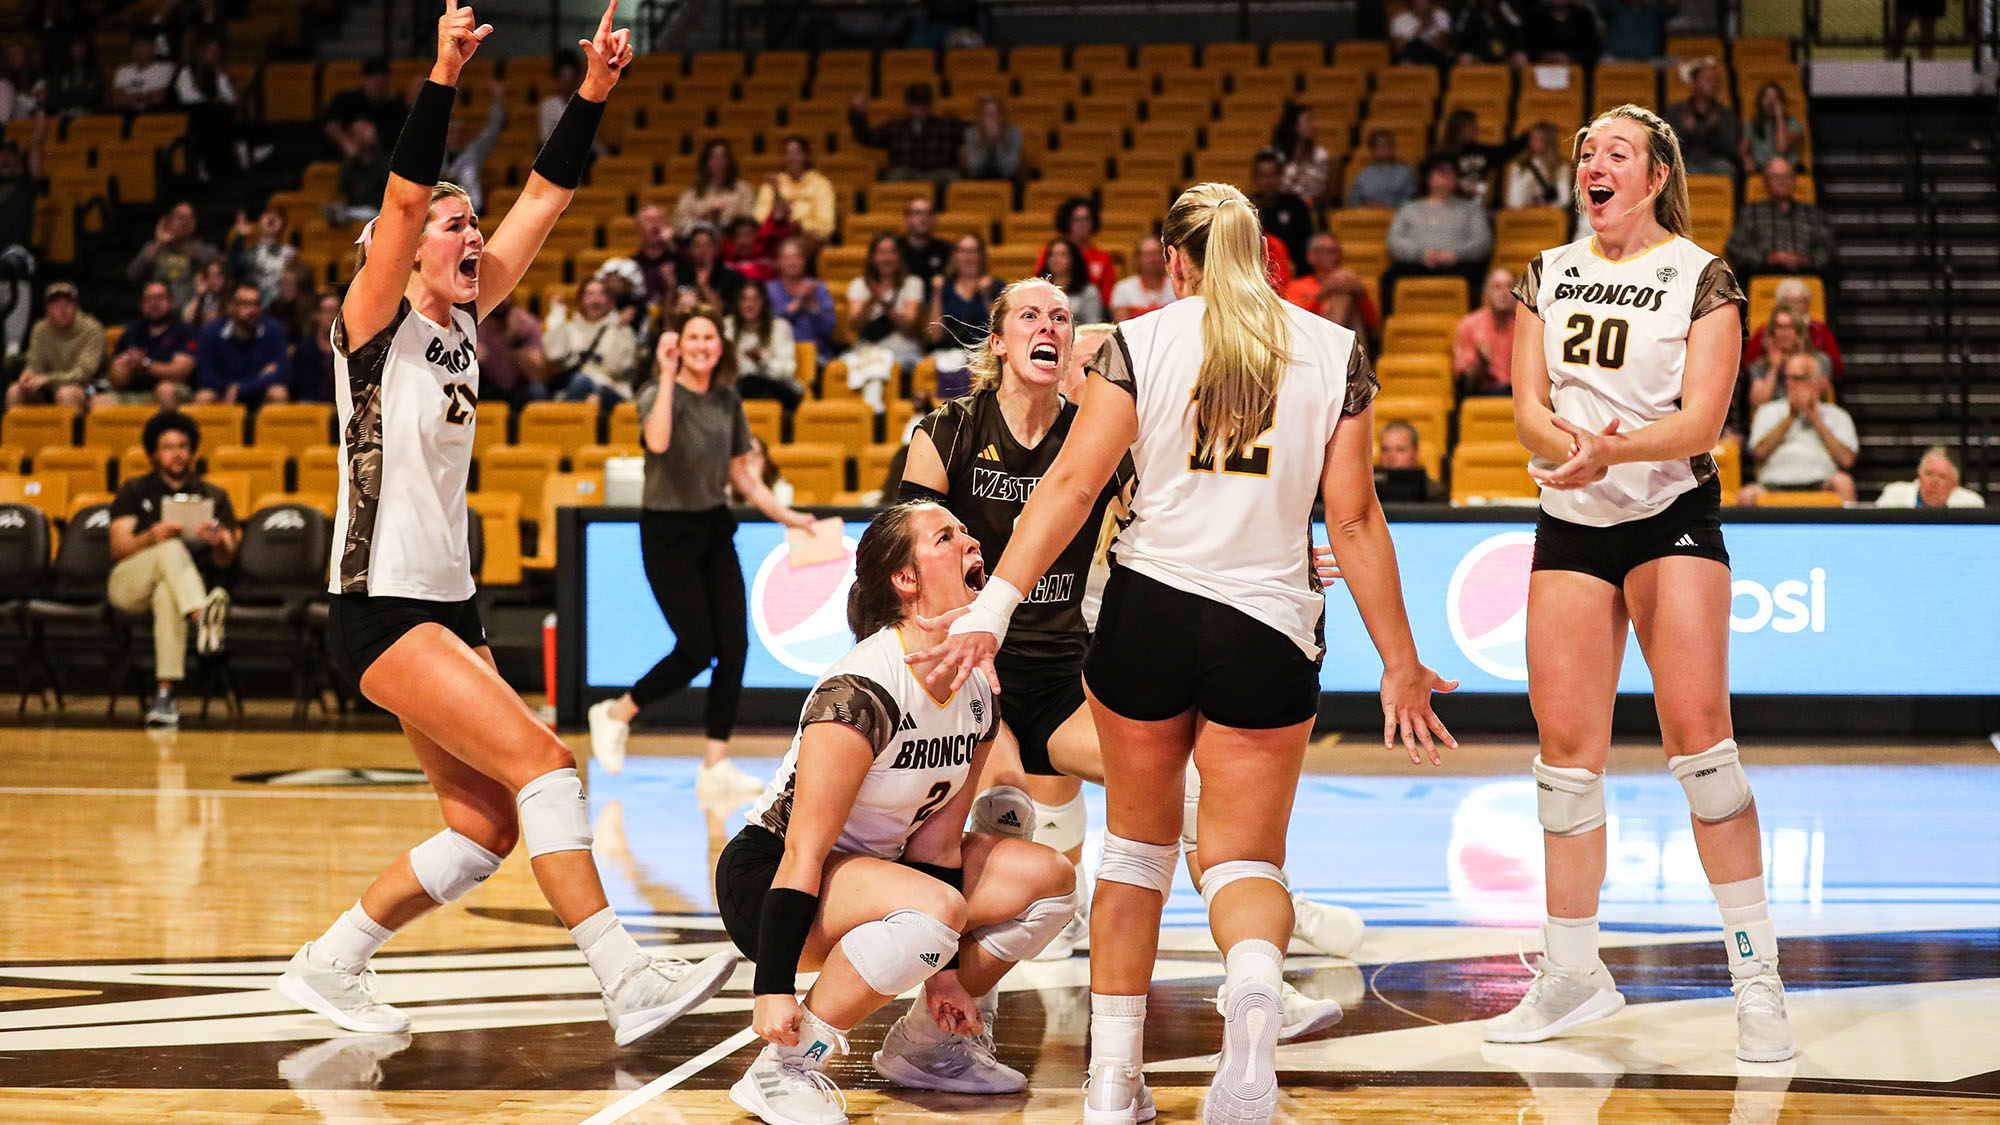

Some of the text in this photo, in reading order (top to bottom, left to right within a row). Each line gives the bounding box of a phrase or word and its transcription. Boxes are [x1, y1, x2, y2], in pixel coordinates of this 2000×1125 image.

[1562, 312, 1630, 371] 20
[972, 467, 1043, 503] WEST
[890, 732, 981, 770] BRONCO
[910, 780, 952, 826] 2
